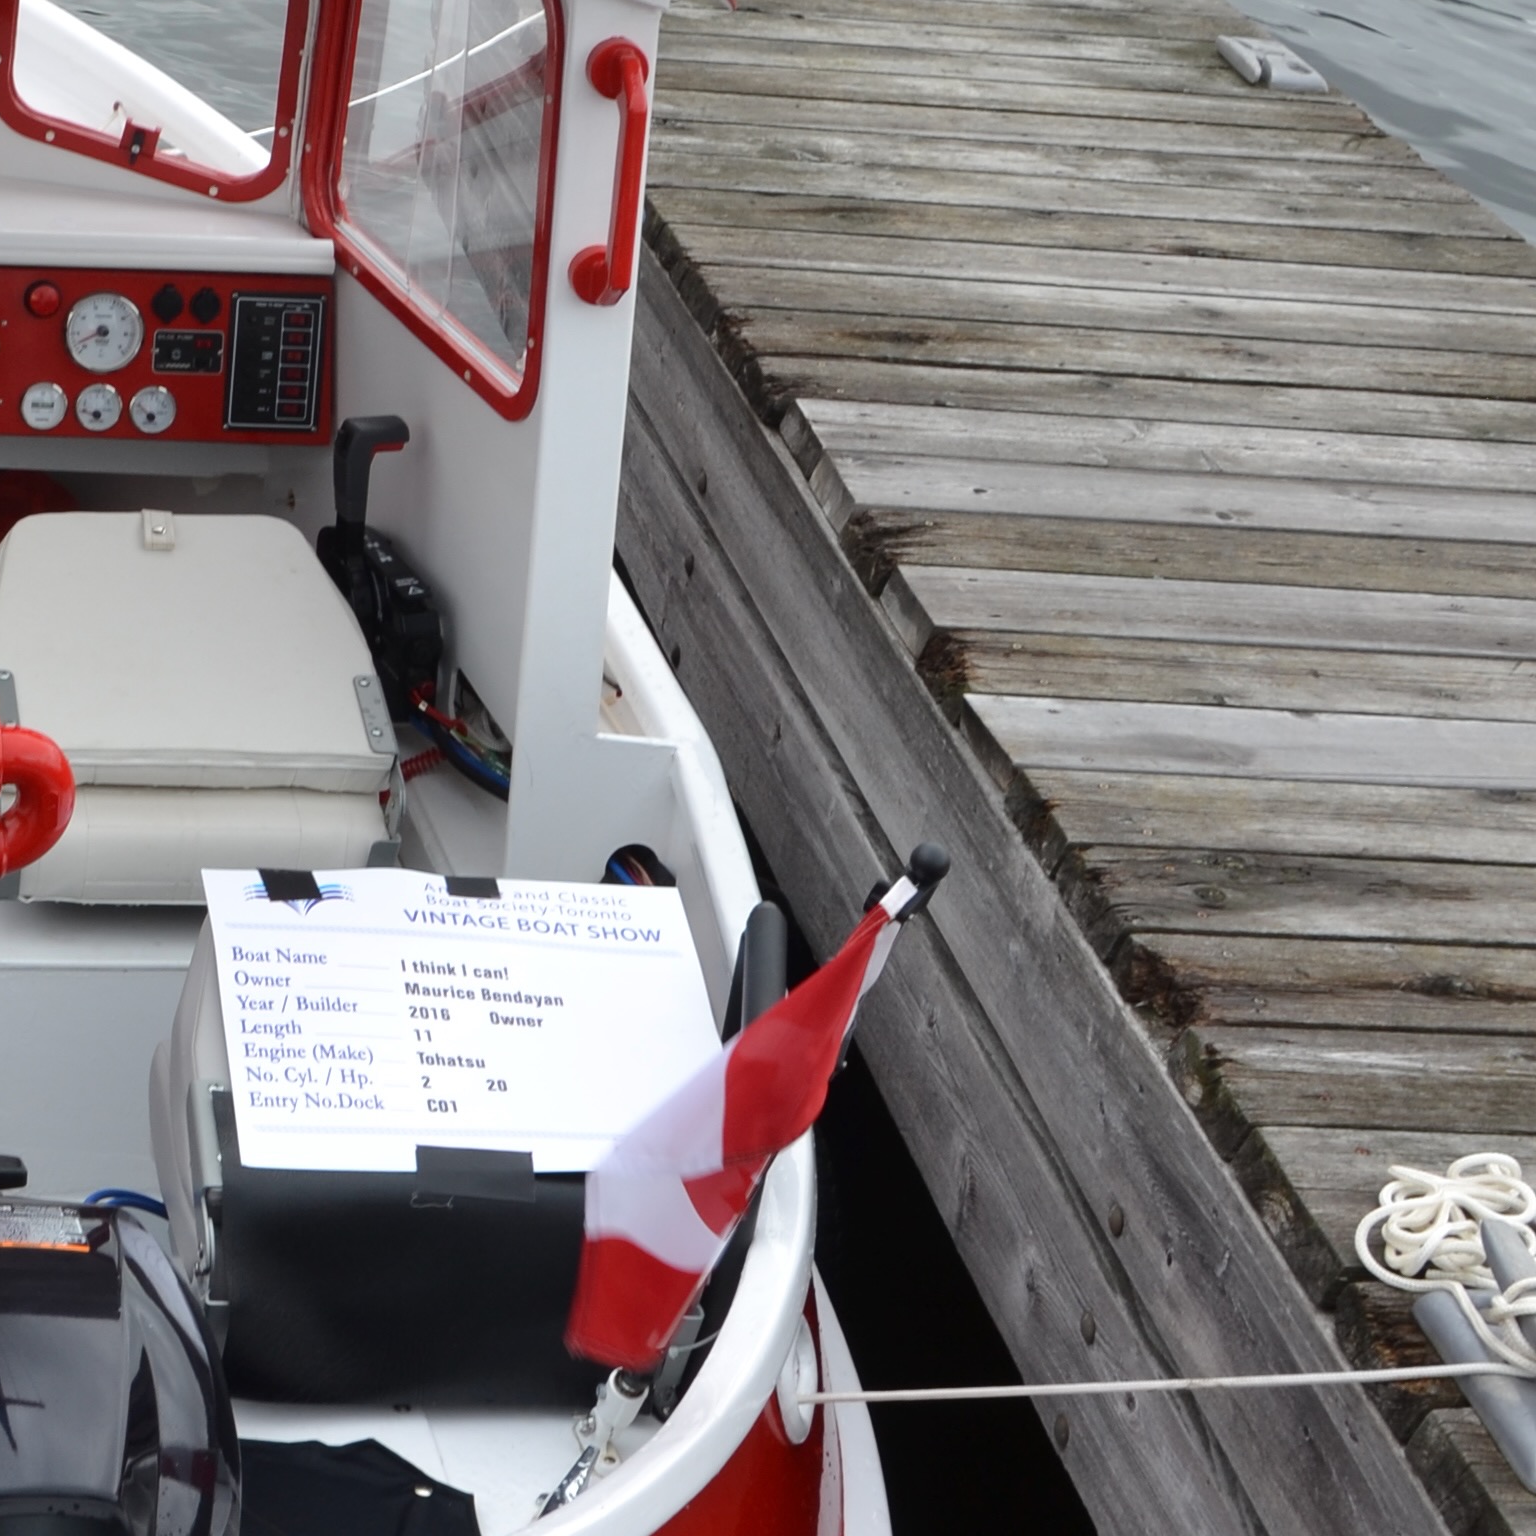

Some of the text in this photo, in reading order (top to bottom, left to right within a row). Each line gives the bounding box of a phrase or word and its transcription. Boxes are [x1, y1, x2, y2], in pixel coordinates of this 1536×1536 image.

[425, 894, 471, 908] Boat
[513, 890, 629, 908] and Classic
[403, 908, 662, 943] VINTAGE BOAT SHOW
[230, 945, 329, 966] Boat Name
[233, 969, 292, 988] Owner
[400, 958, 510, 981] I think I can!
[235, 994, 359, 1014] Year / Builder
[404, 981, 565, 1009] Maurice Bendayan
[408, 1005, 544, 1028] 2016 Owner
[239, 1018, 303, 1040] Length
[413, 1028, 433, 1043] 11
[243, 1041, 375, 1065] Engine (Make)
[416, 1051, 487, 1070] Tohatsu
[245, 1065, 374, 1089] No. Cyl. / Hp.
[420, 1075, 509, 1094] 2 20
[248, 1090, 386, 1113] Entry No.Dock
